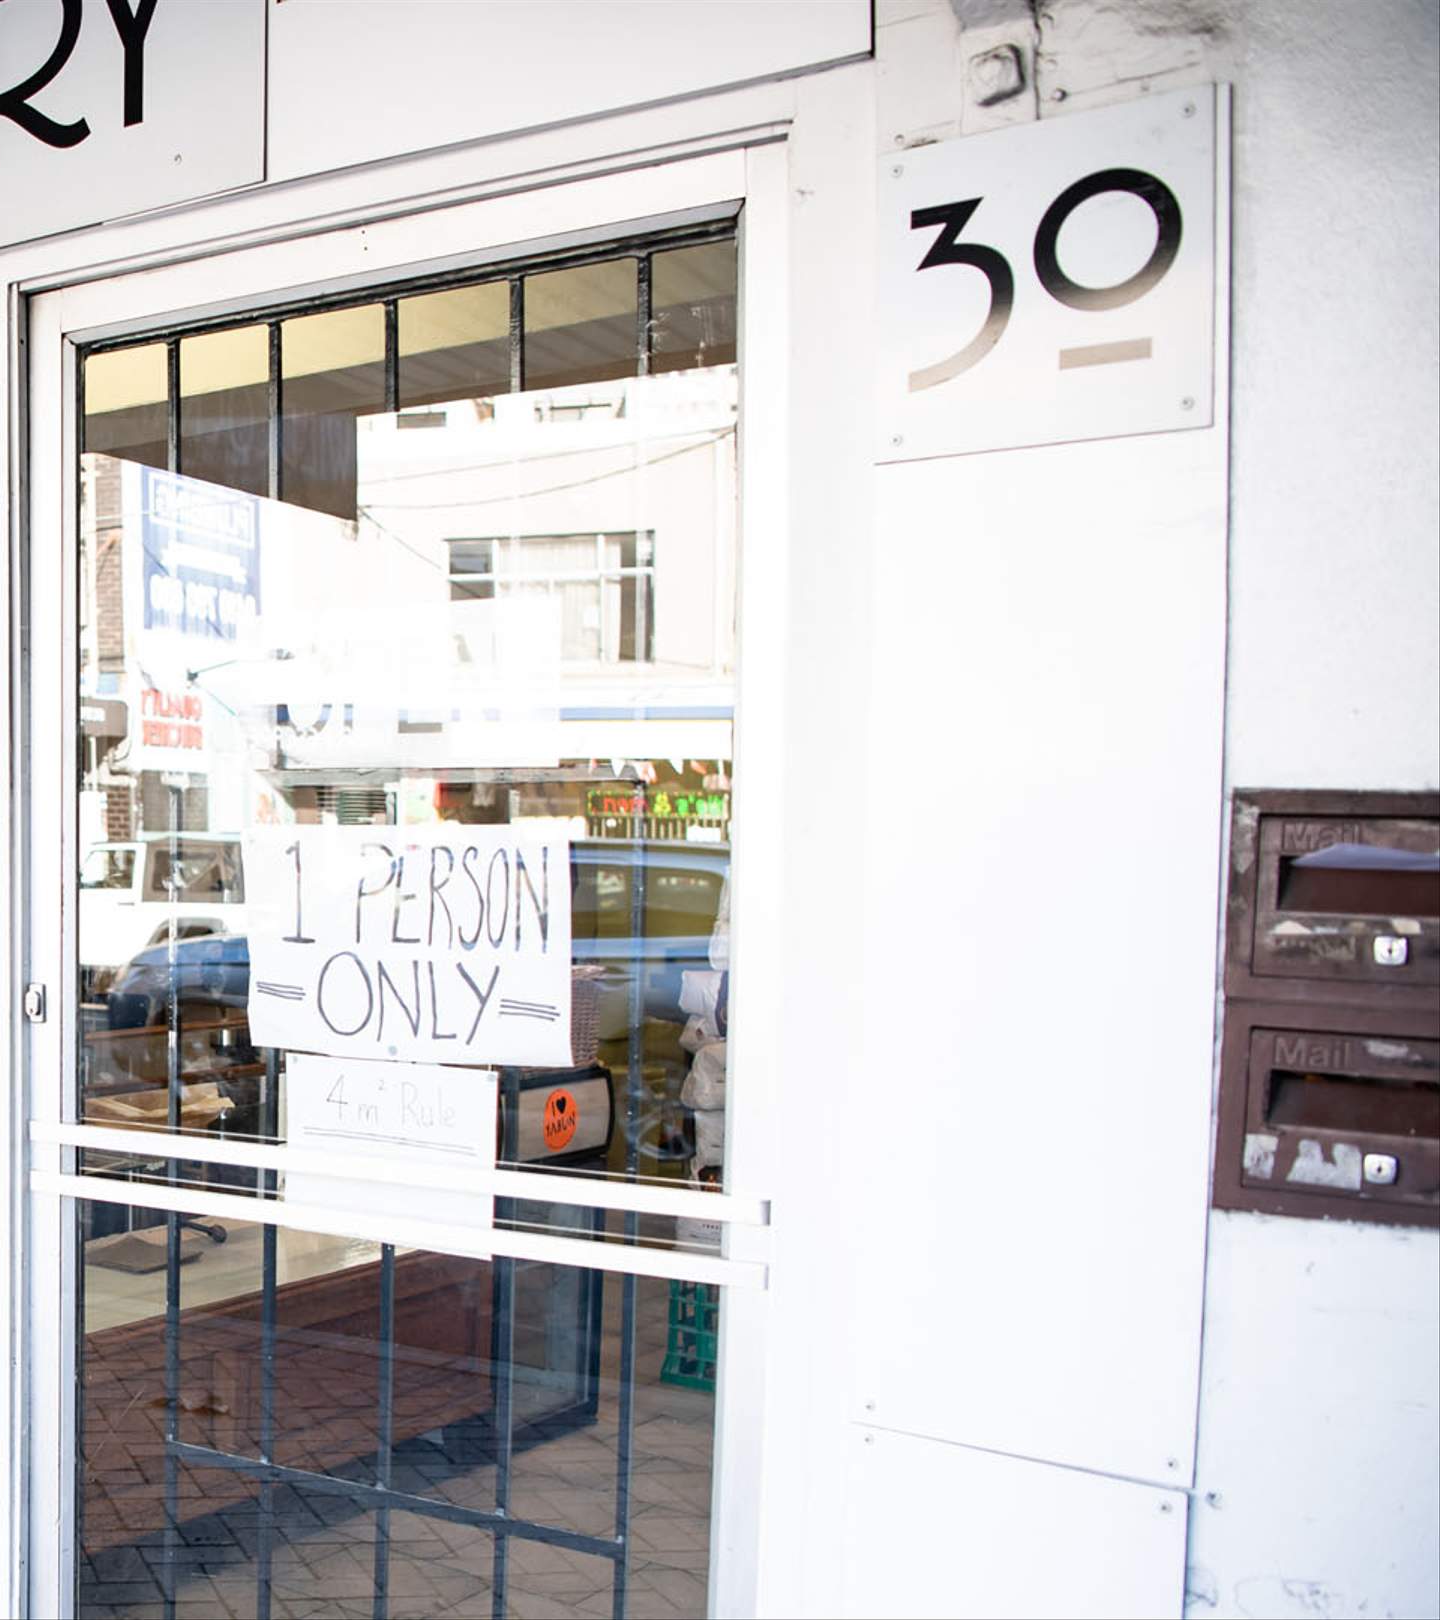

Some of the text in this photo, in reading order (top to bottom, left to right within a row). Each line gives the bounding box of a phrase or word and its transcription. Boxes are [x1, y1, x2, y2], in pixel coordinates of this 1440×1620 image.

[907, 166, 1184, 393] 30
[1281, 820, 1361, 851] Mail
[282, 840, 551, 954] 1 PERSON
[316, 950, 500, 1046] ONLY
[1273, 1035, 1353, 1069] Mail
[400, 1081, 457, 1129] Rule
